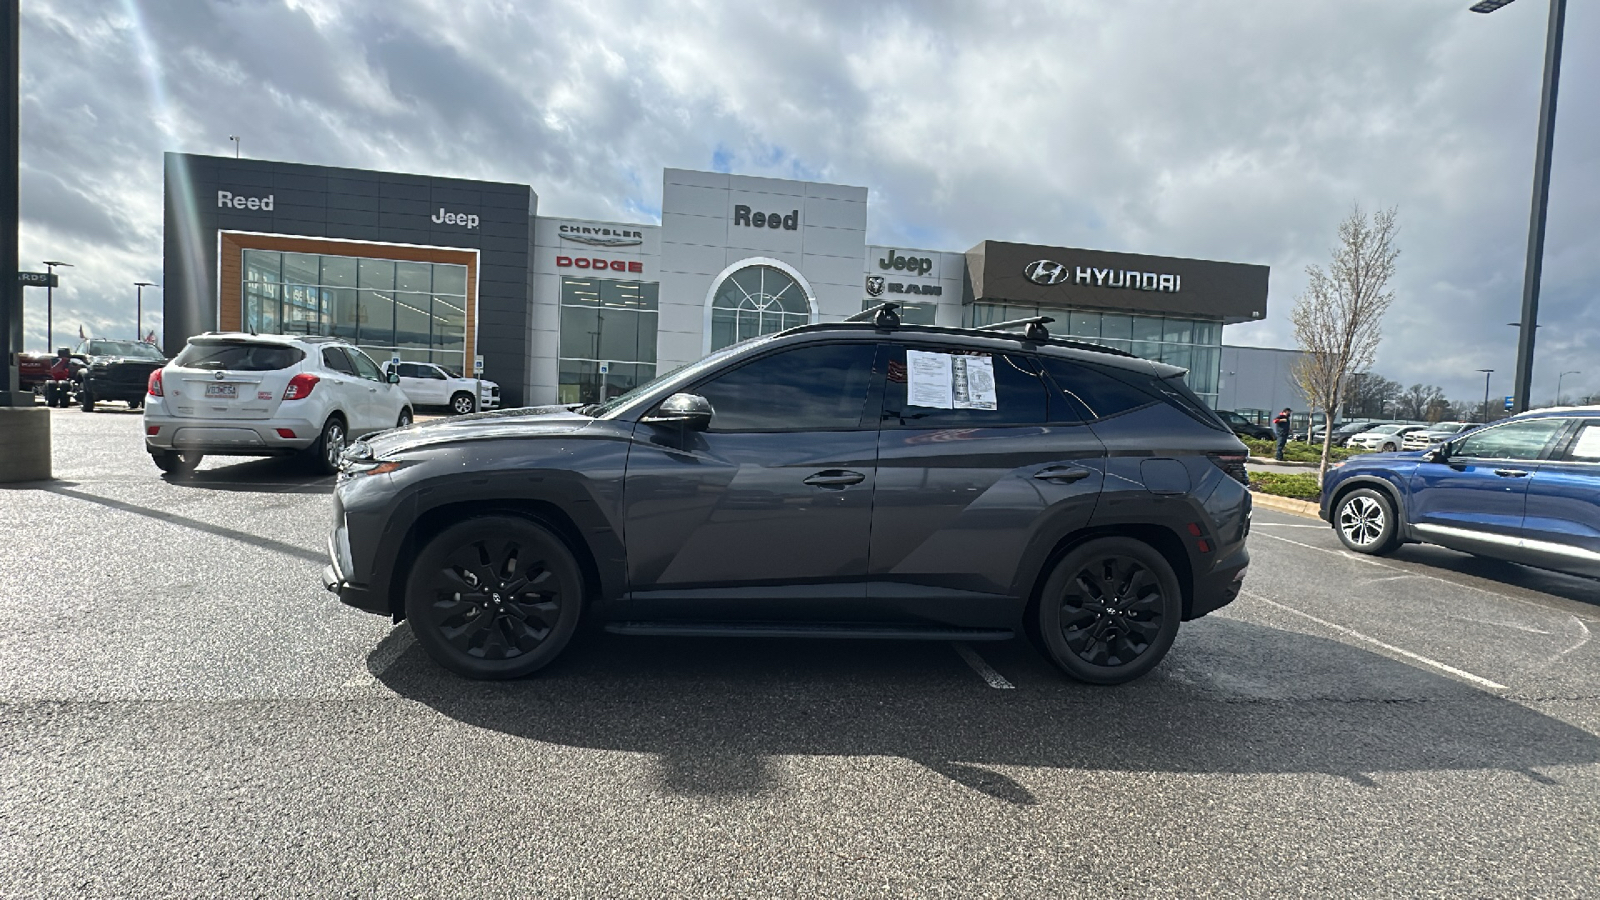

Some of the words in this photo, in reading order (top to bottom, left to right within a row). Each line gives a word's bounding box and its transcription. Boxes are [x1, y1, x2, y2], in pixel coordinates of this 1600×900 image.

[217, 190, 275, 211] Reed
[431, 208, 480, 229] Jeep
[734, 204, 799, 231] Reed
[559, 225, 643, 239] CHRYSLER
[556, 256, 643, 273] DODGE
[879, 249, 933, 276] Jeep
[18, 273, 48, 282] RDS
[1074, 266, 1182, 293] HYUNDAI
[887, 282, 943, 296] RAM
